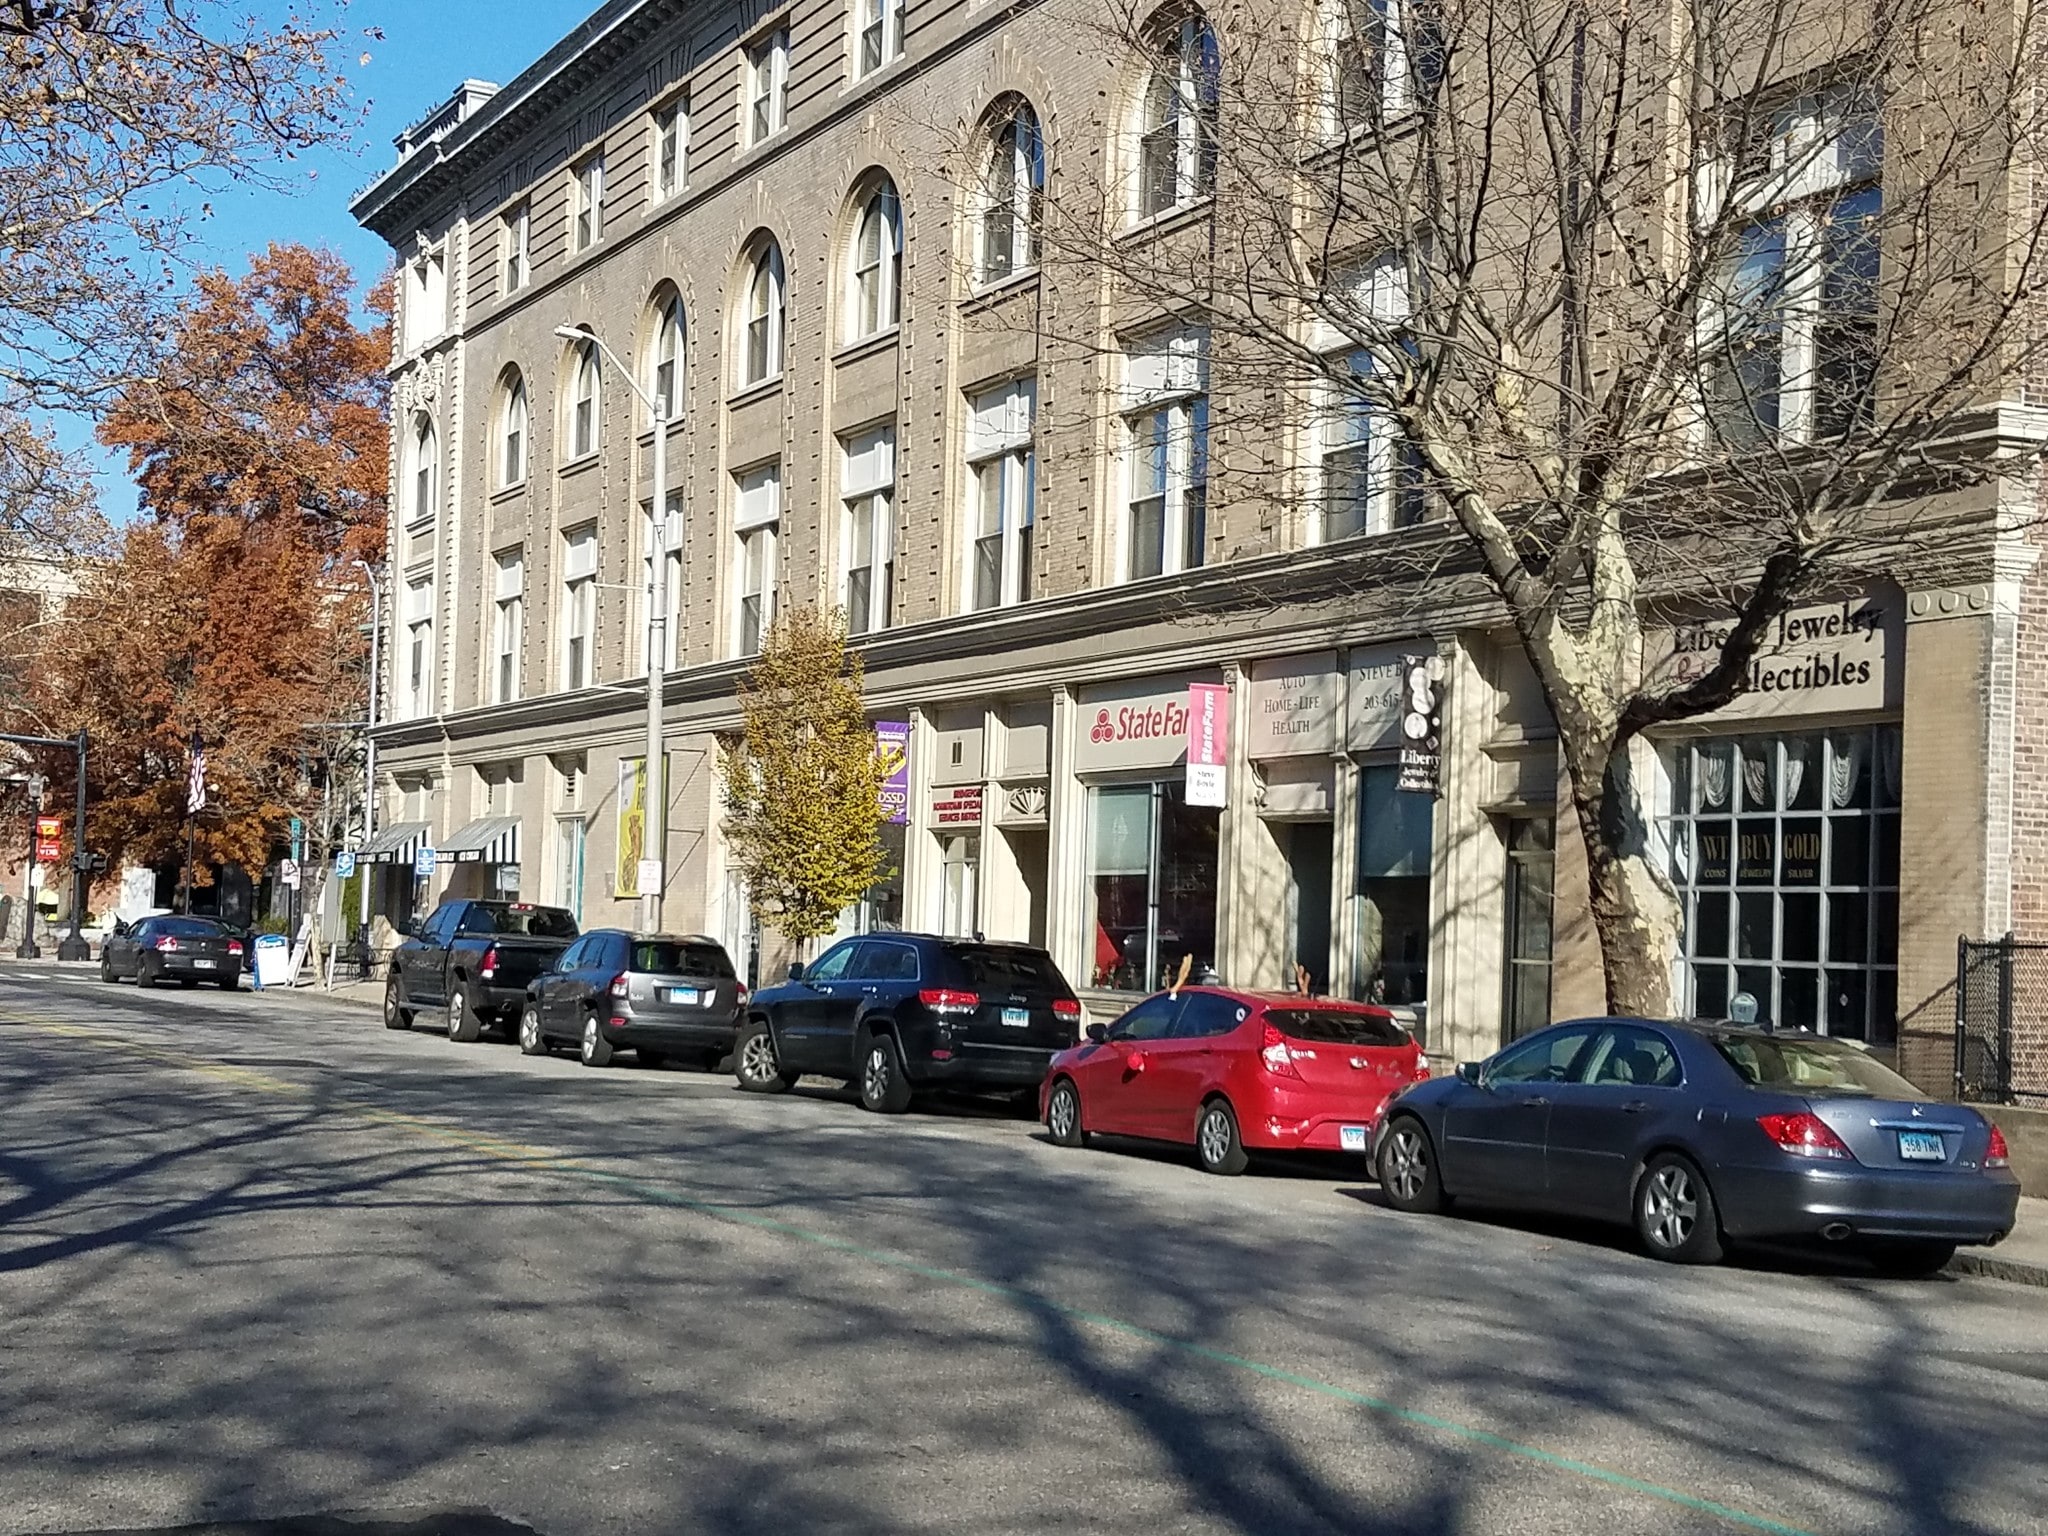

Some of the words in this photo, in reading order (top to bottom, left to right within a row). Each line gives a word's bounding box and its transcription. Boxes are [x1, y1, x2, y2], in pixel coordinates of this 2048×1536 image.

[1779, 600, 1884, 647] Jewelry
[1359, 664, 1393, 682] STEVE
[1754, 652, 1871, 693] lectibles
[1279, 676, 1306, 690] AUTO
[1364, 693, 1403, 710] 203-615-
[1117, 702, 1190, 741] StateFar
[1201, 690, 1215, 763] StateFarm
[1272, 720, 1310, 736] HEALTH
[1400, 749, 1441, 769] Liberty
[877, 792, 905, 803] DSSD
[1740, 834, 1772, 860] BUY
[1784, 833, 1820, 860] GOLD
[1704, 868, 1727, 879] COINS
[1788, 869, 1814, 879] SILVER
[1008, 993, 1027, 1003] Jeep
